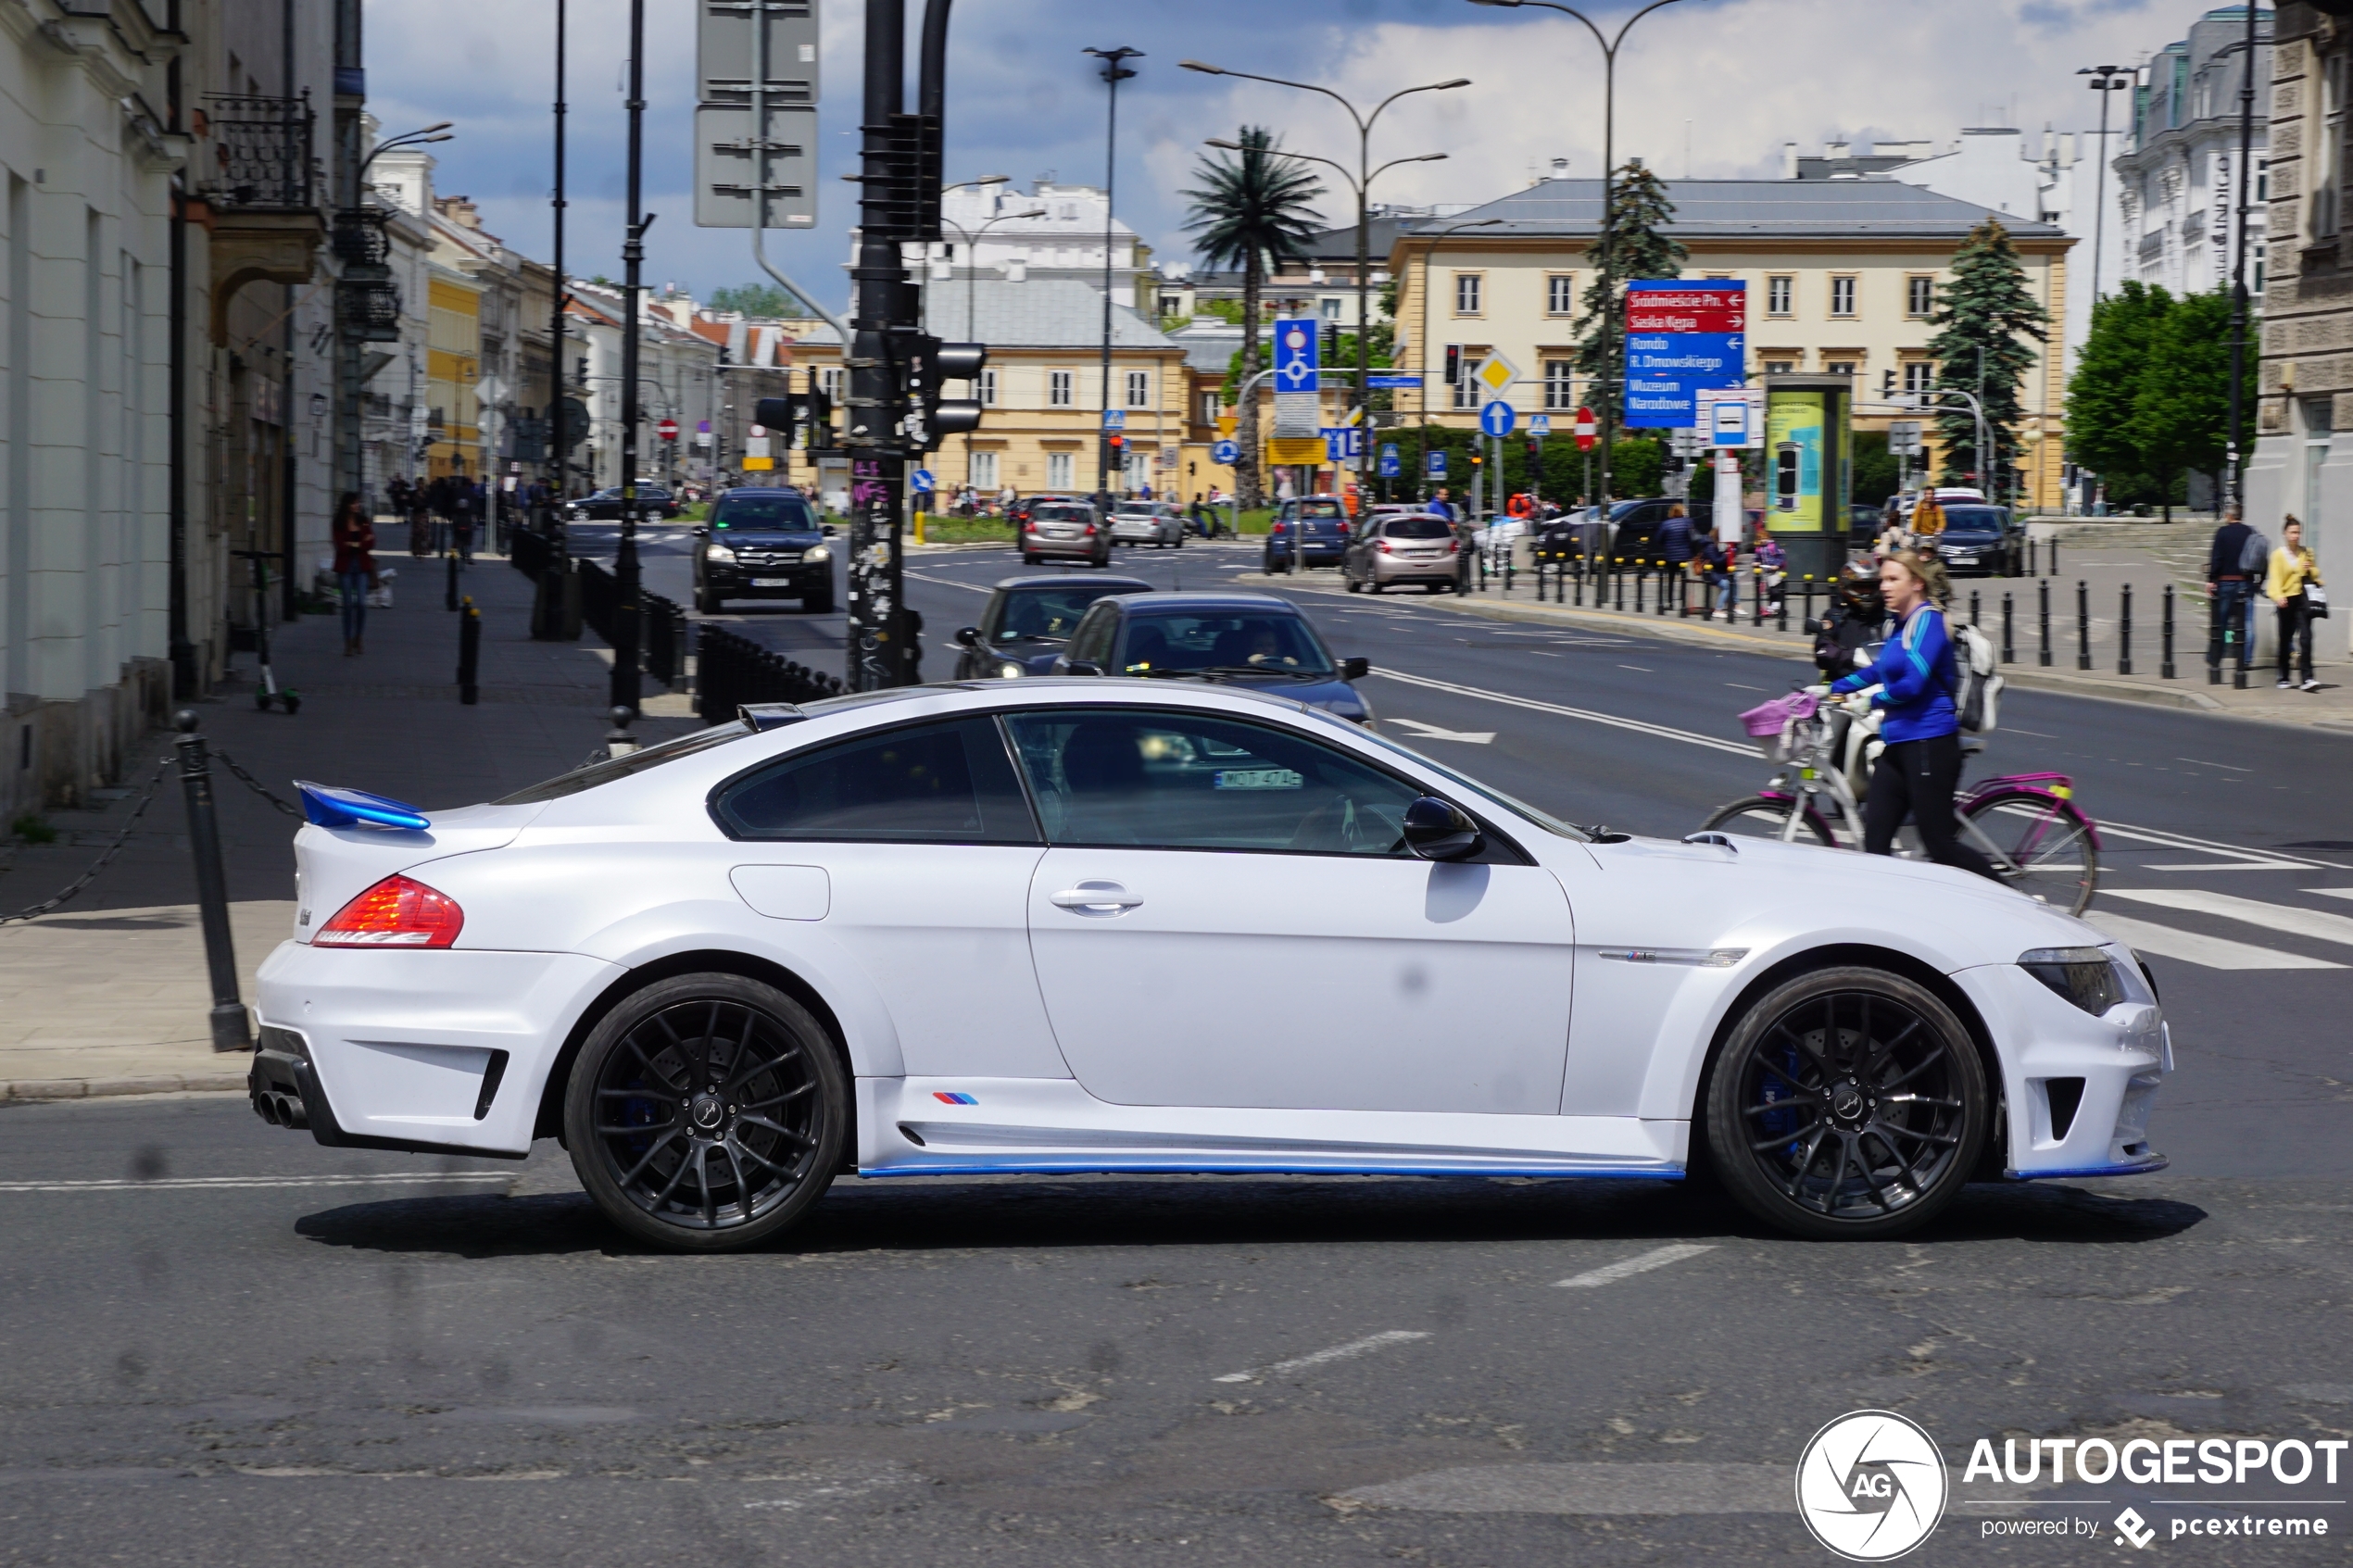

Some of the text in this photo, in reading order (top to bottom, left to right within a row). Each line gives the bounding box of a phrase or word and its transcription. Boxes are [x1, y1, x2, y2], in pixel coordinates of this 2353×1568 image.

[1630, 292, 1724, 307] Śródmieście Pn.
[1630, 315, 1664, 328] Saska
[1630, 337, 1668, 349] Rondo
[1629, 355, 1722, 371] R. Dmowskiego
[1629, 380, 1680, 392] Muzeum
[1629, 396, 1692, 409] Narodowe
